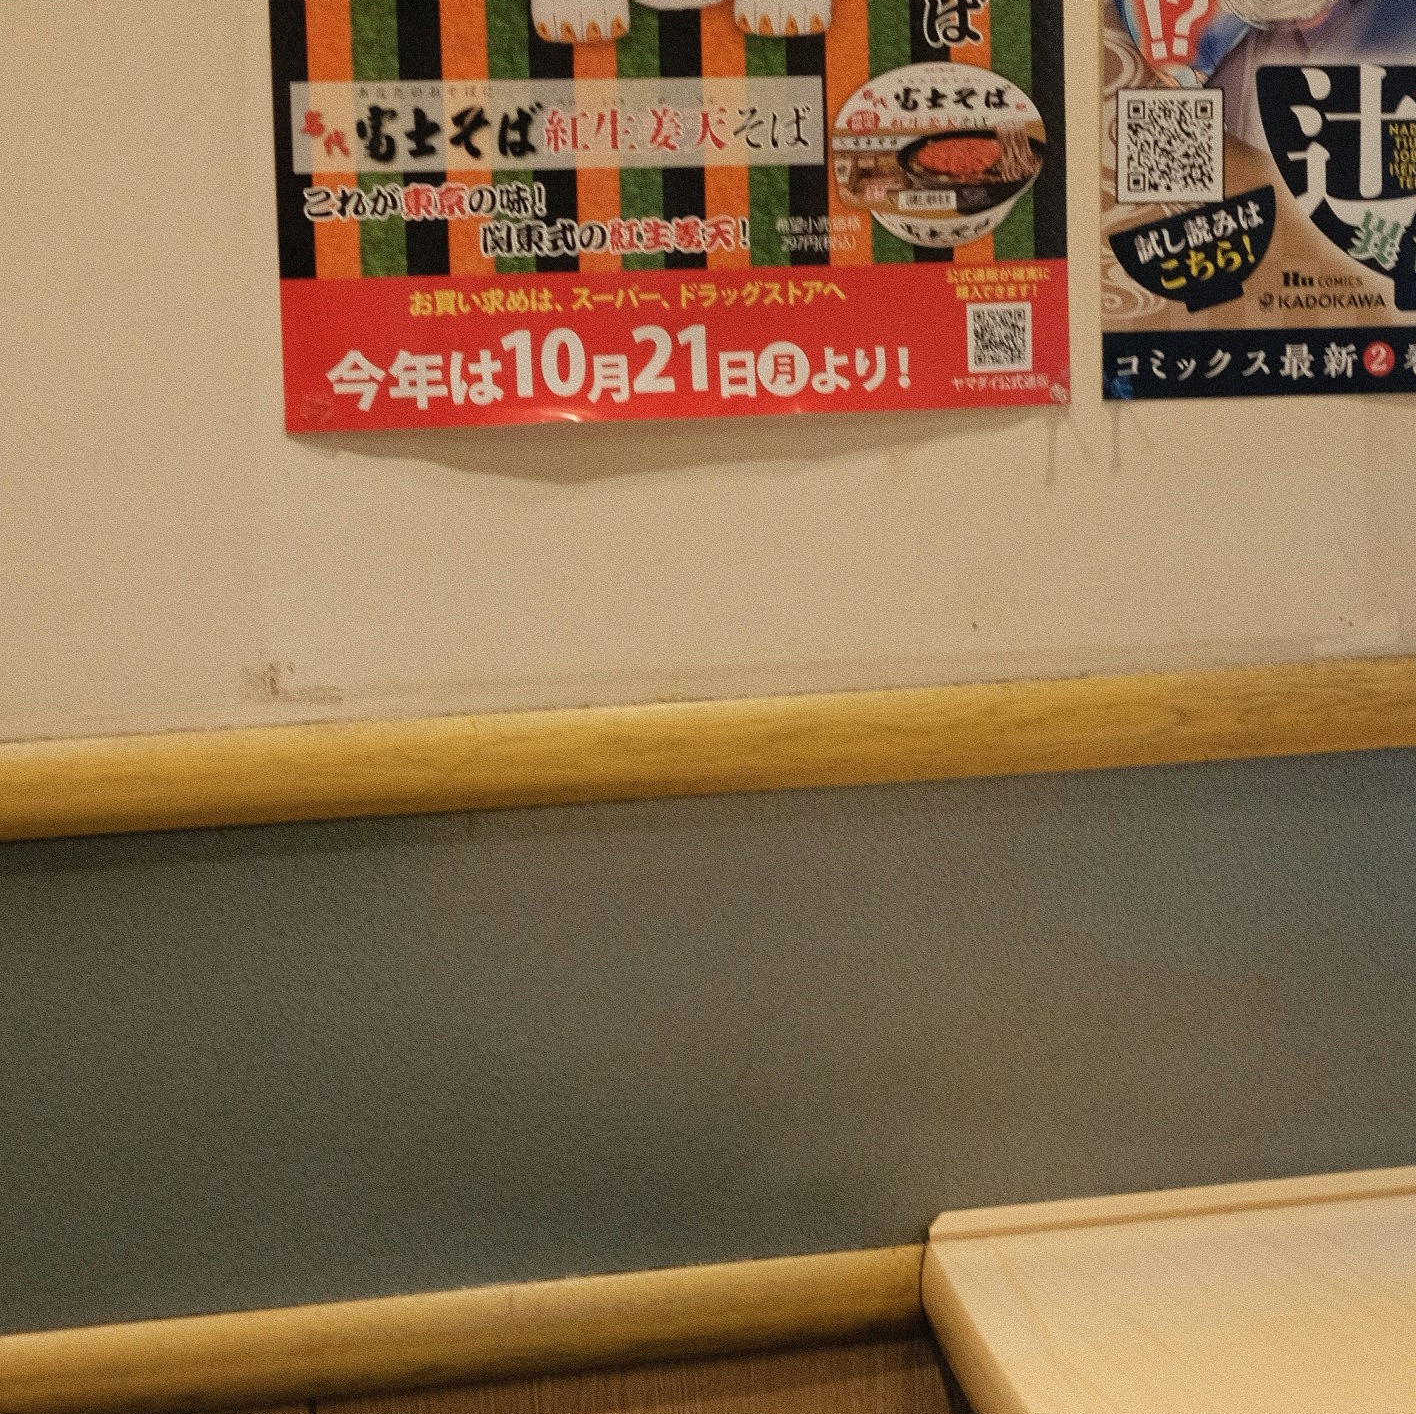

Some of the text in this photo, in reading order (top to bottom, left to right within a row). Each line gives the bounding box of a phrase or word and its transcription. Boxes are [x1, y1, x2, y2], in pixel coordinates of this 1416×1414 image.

[1135, 200, 1264, 265] 試し読みは
[1318, 274, 1363, 286] COMICS
[1278, 293, 1386, 310] KADOKAWA
